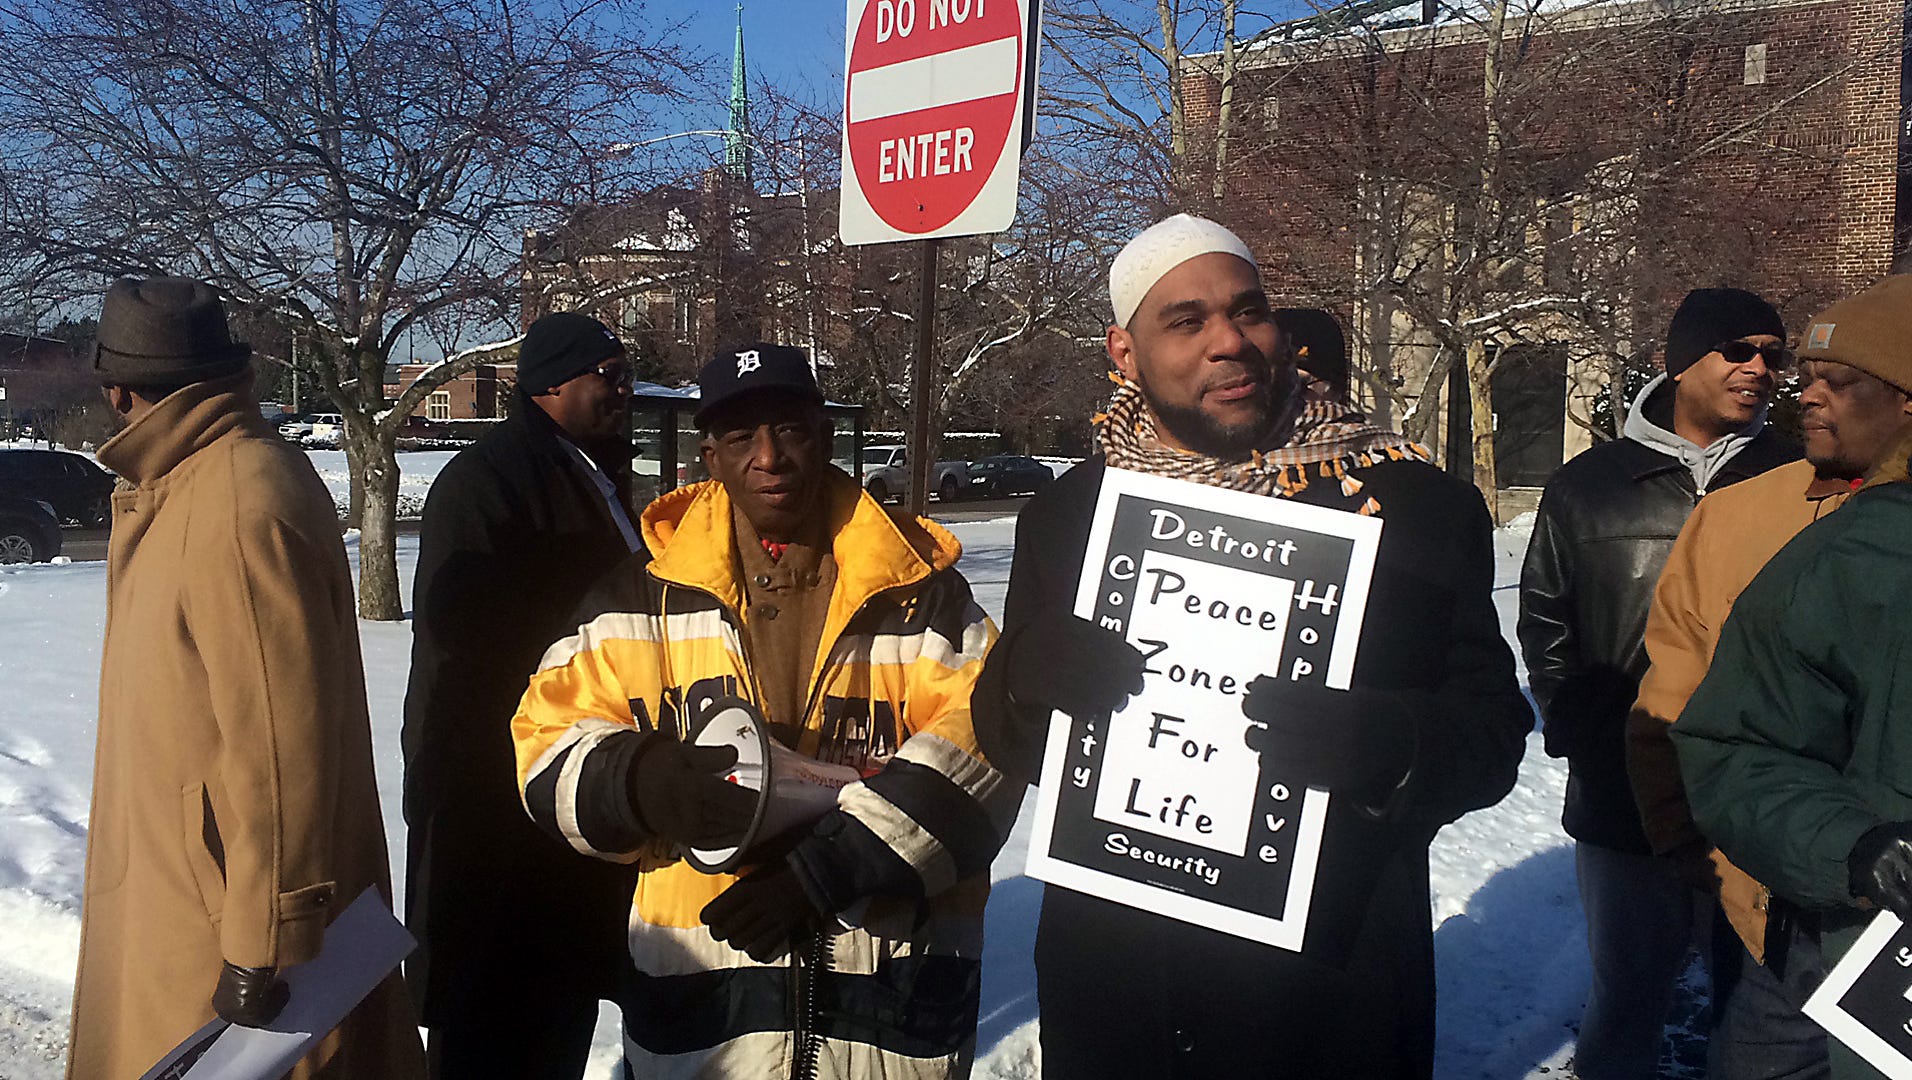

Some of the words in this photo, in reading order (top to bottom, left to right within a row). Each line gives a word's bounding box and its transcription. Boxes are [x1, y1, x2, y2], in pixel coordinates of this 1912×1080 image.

[877, 0, 915, 43] DO
[879, 127, 975, 183] ENTER
[735, 350, 761, 378] D
[1149, 508, 1298, 566] Detroit
[1146, 568, 1276, 630] Peace
[1291, 579, 1338, 681] Hop
[1073, 554, 1135, 788] Comty
[1148, 712, 1219, 762] For
[1124, 778, 1213, 834] Life
[1104, 832, 1220, 885] Security
